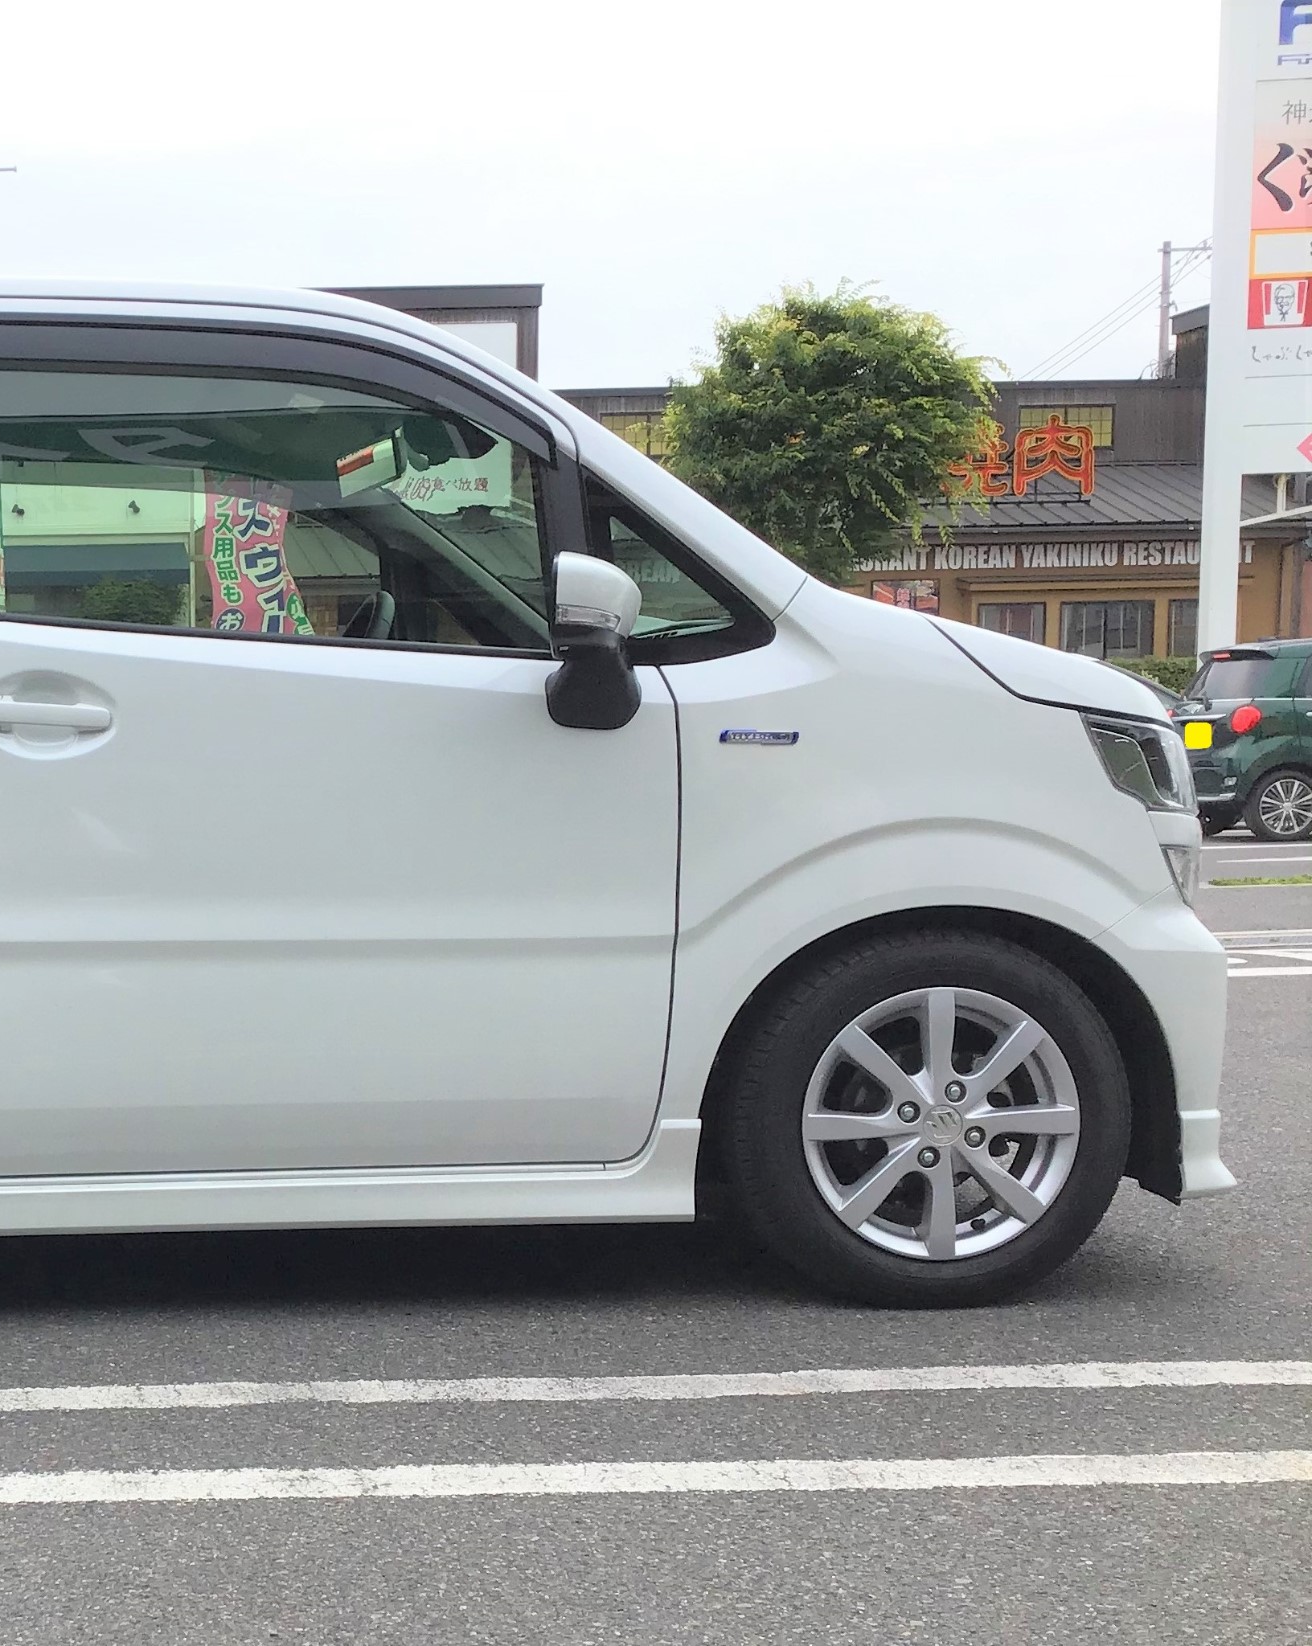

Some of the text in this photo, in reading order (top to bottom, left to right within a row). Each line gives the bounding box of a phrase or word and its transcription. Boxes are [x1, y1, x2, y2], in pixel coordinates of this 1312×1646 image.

[1281, 99, 1312, 125] 神
[934, 544, 1016, 570] KOREAN
[1021, 542, 1119, 568] YAKINIKU
[1123, 540, 1256, 567] RESTAUT
